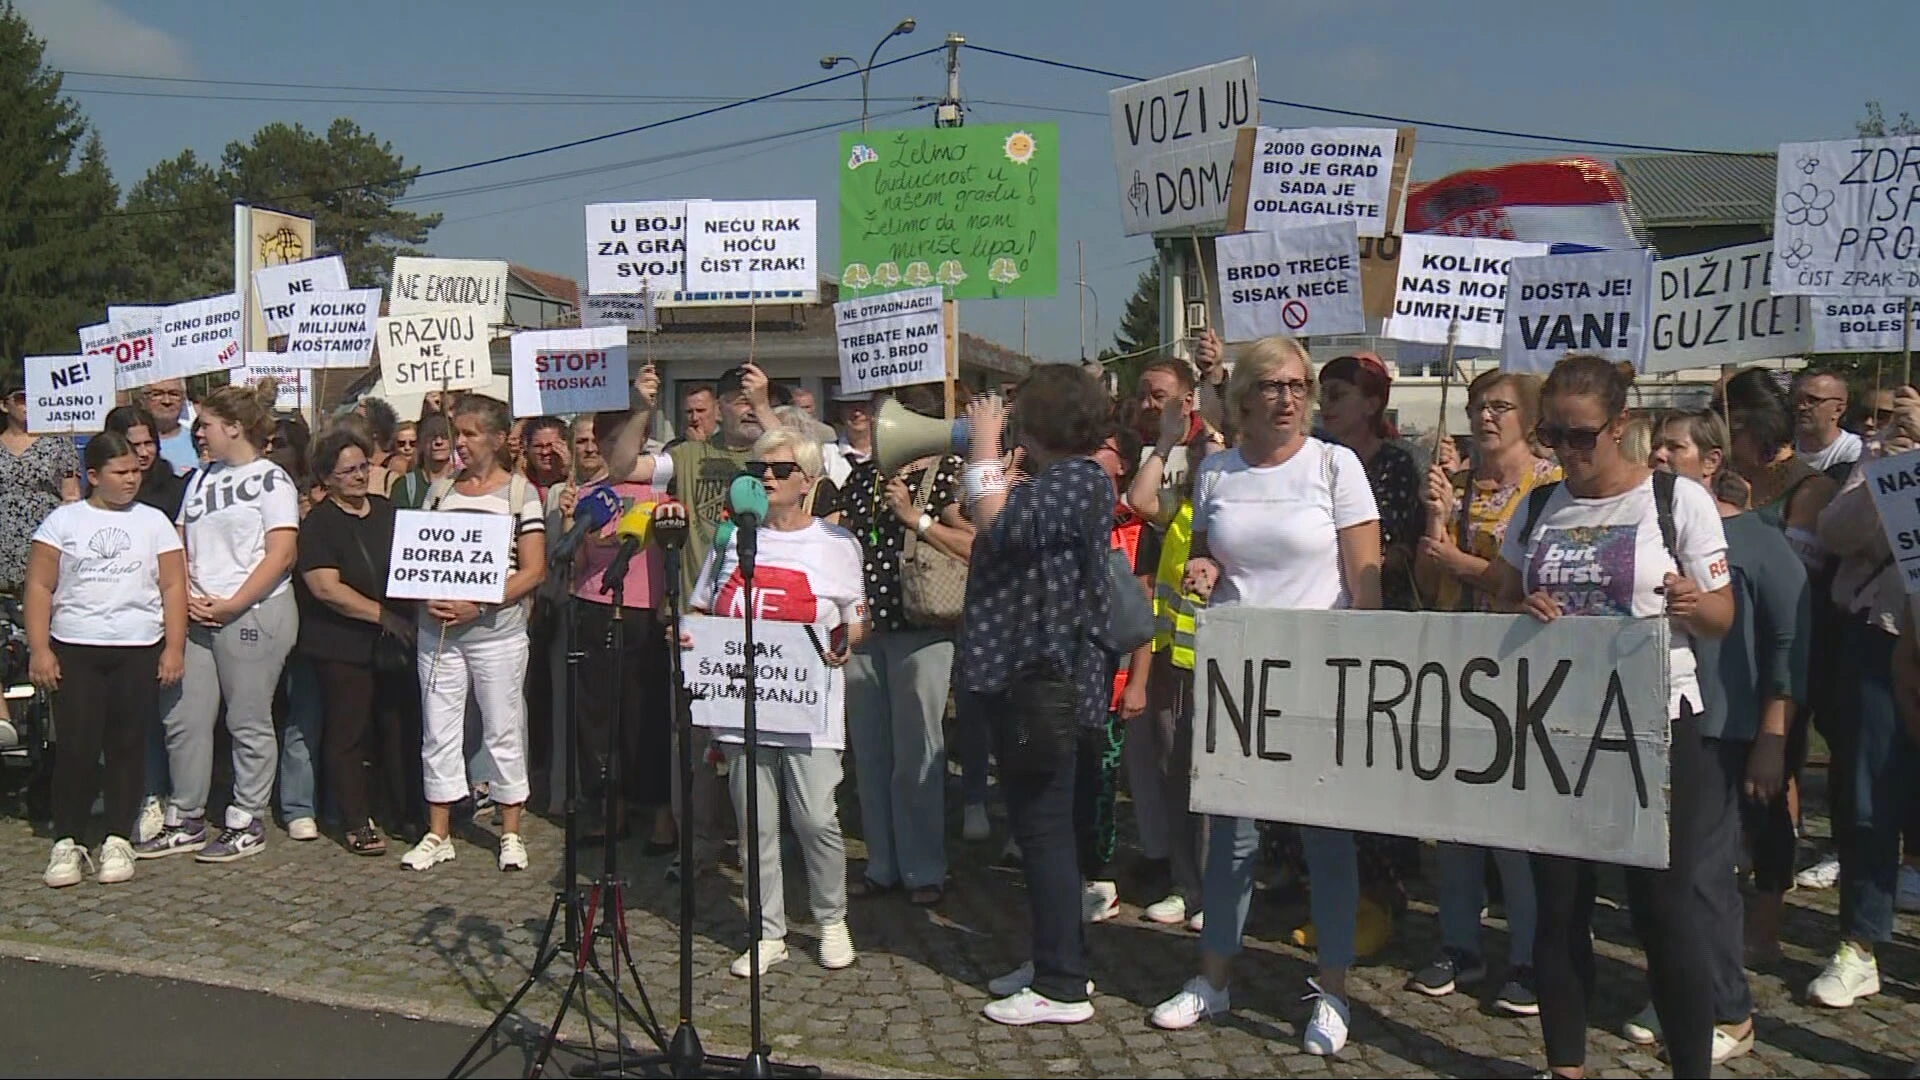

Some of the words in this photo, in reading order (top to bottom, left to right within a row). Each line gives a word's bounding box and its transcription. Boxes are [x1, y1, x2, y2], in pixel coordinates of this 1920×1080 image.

[1125, 86, 1207, 146] VOZI
[1218, 78, 1249, 129] JU
[1263, 142, 1305, 156] 2000
[1310, 143, 1382, 158] GODINA
[1263, 161, 1293, 174] BIO
[1299, 162, 1321, 176] JE
[1327, 164, 1378, 178] GRAD
[1280, 181, 1327, 195] SADA
[1332, 183, 1356, 196] JE
[1253, 199, 1379, 218] ODLAGALIŠTE
[611, 218, 626, 234] U
[704, 217, 755, 234] NEĆU
[762, 218, 800, 233] RAK
[936, 212, 954, 231] da
[598, 240, 629, 256] ZA
[724, 235, 776, 252] HOĆU
[1835, 226, 1920, 263] PRO
[700, 256, 742, 273] ČIST
[750, 257, 805, 271] ZRAK!
[1227, 263, 1281, 281] BRDO
[1286, 254, 1350, 276] TREĆE
[1401, 276, 1450, 294] NAS
[1798, 266, 1833, 287] ČIST
[288, 278, 314, 295] NE
[397, 273, 421, 300] NE
[1232, 285, 1290, 304] SISAK
[1297, 277, 1349, 298] NEĆE
[1521, 281, 1591, 301] DOSTA
[1597, 278, 1632, 297] JE!
[310, 302, 366, 317] KOLIKO
[843, 309, 858, 320] NE
[1826, 302, 1876, 317] SADA
[164, 317, 201, 334] CRNO
[205, 310, 241, 326] BRDO
[298, 321, 366, 334] MILIJUNA
[388, 314, 474, 347] RAZVOJ
[1519, 312, 1631, 350] VAN!
[171, 336, 188, 348] JE
[191, 327, 233, 344] GRDO!
[291, 337, 371, 352] KOŠTAMO?
[841, 329, 901, 349] TREBATE
[906, 323, 938, 339] NAM
[217, 340, 240, 364] NE!
[420, 344, 443, 357] NE
[851, 351, 869, 364] KO
[873, 348, 885, 360] 3.
[889, 342, 928, 358] BRDO
[535, 351, 607, 373] STOP!
[857, 368, 866, 380] U
[870, 360, 923, 378] GRADU!
[50, 362, 91, 390] NE!
[535, 376, 607, 391] TROSKA!
[38, 395, 93, 407] GLASNO
[98, 395, 103, 405] I
[46, 411, 95, 422] JASNO!
[418, 528, 455, 542] OVO
[461, 529, 482, 543] JE
[402, 547, 464, 563] BORBA
[470, 550, 494, 564] ZA
[1543, 544, 1598, 561] but
[394, 567, 498, 585] OPSTANAK!
[724, 640, 783, 659] SIAK
[699, 656, 788, 681] ŠAMION
[794, 667, 808, 682] U
[1206, 658, 1292, 761] NE
[1326, 657, 1648, 809] TROSKA
